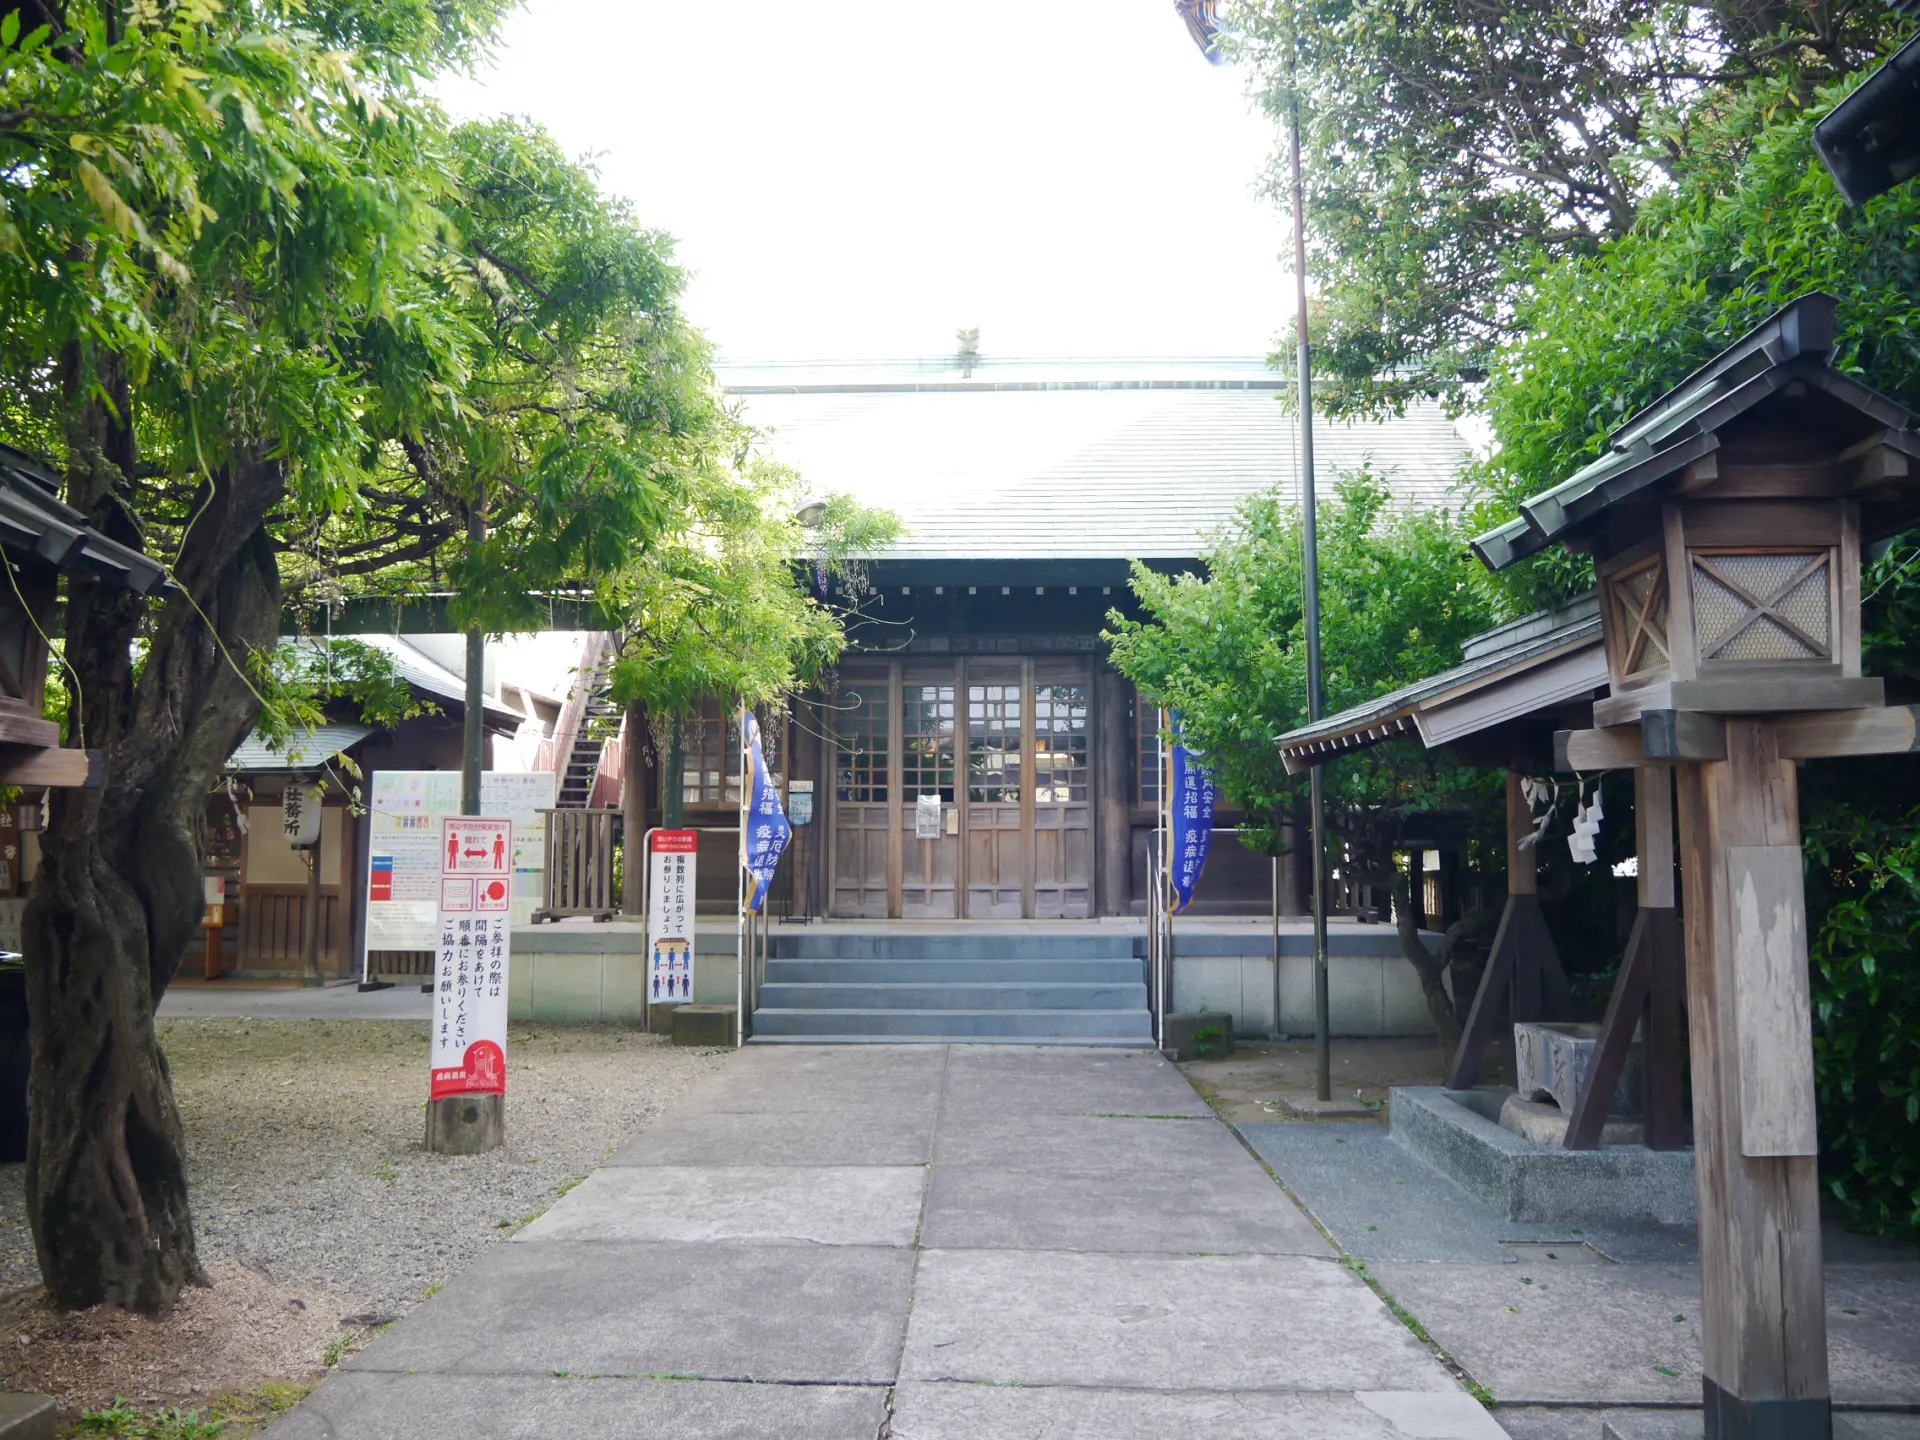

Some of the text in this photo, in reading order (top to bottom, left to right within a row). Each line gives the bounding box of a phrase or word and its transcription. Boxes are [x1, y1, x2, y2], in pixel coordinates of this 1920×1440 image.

[284, 786, 304, 836] 社務所
[449, 823, 507, 832] 感染予防対策実施中
[465, 836, 487, 844] 離れて
[459, 860, 491, 868] お並びください
[662, 855, 672, 934] お参りしましょう
[675, 855, 685, 933] 複数列に広がって
[439, 918, 455, 1050] ご協力お願いします
[455, 919, 471, 1048] 順番にお参りください
[473, 918, 487, 998] 間隔をあけて
[489, 918, 504, 997] ご参拝の際は
